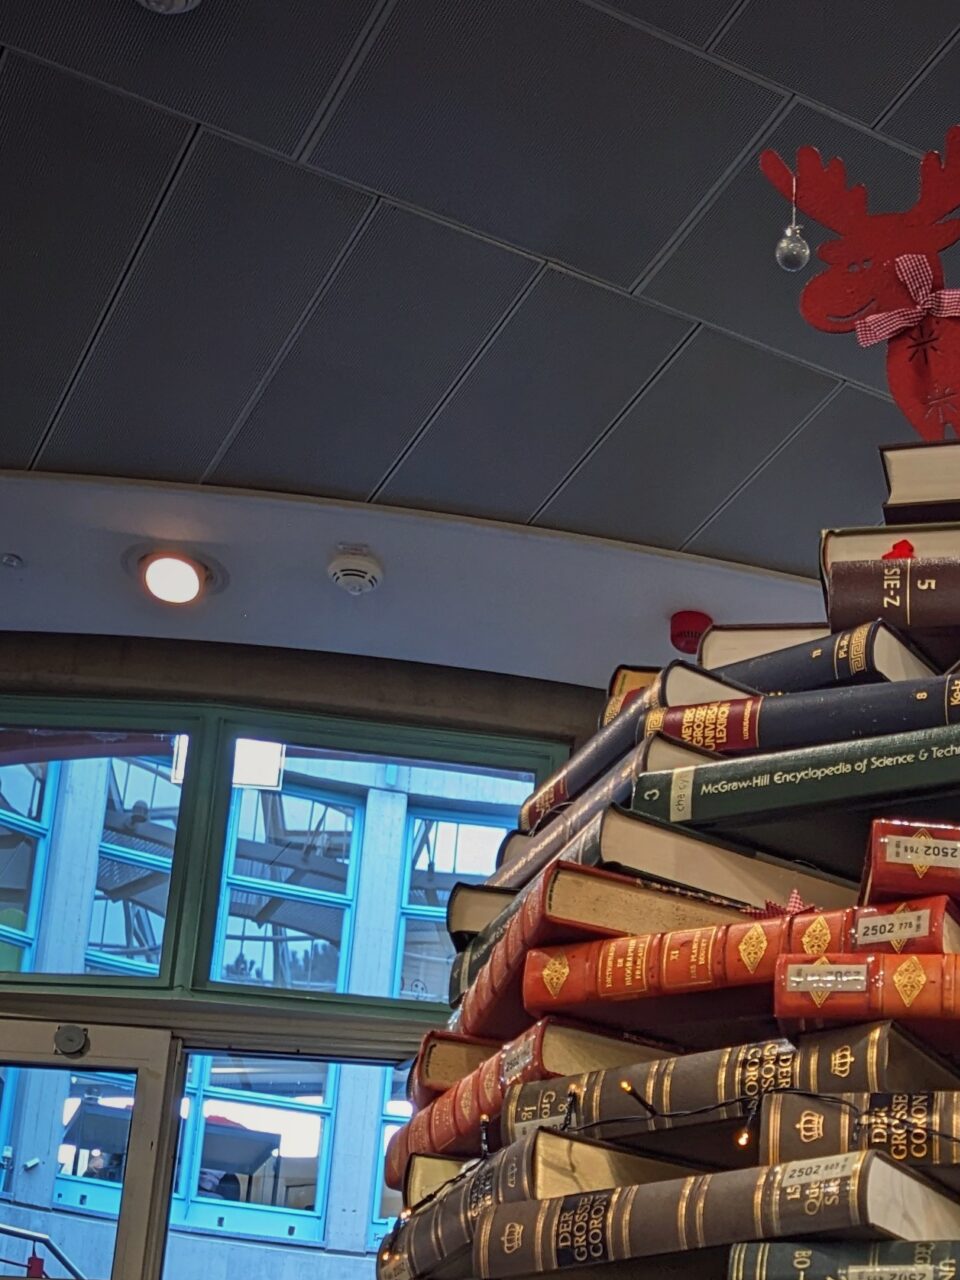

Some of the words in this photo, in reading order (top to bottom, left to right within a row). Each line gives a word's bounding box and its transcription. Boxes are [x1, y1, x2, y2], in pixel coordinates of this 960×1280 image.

[883, 568, 900, 608] SIE-Z
[917, 579, 936, 591] 5
[701, 773, 770, 796] McGraw-Hill
[773, 761, 852, 790] Encyclopedia
[854, 757, 868, 774] of
[870, 751, 915, 770] Science
[919, 750, 928, 761] &
[644, 789, 659, 801] 3
[924, 845, 959, 858] 2502
[863, 923, 894, 937] 2502
[871, 1105, 887, 1143] DER
[890, 1094, 908, 1160] GROSSE
[910, 1095, 928, 1158] CORON
[789, 1165, 822, 1179] 2502
[559, 1210, 573, 1249] DER
[574, 1194, 590, 1261] GROSSE
[590, 1193, 607, 1257] CORON
